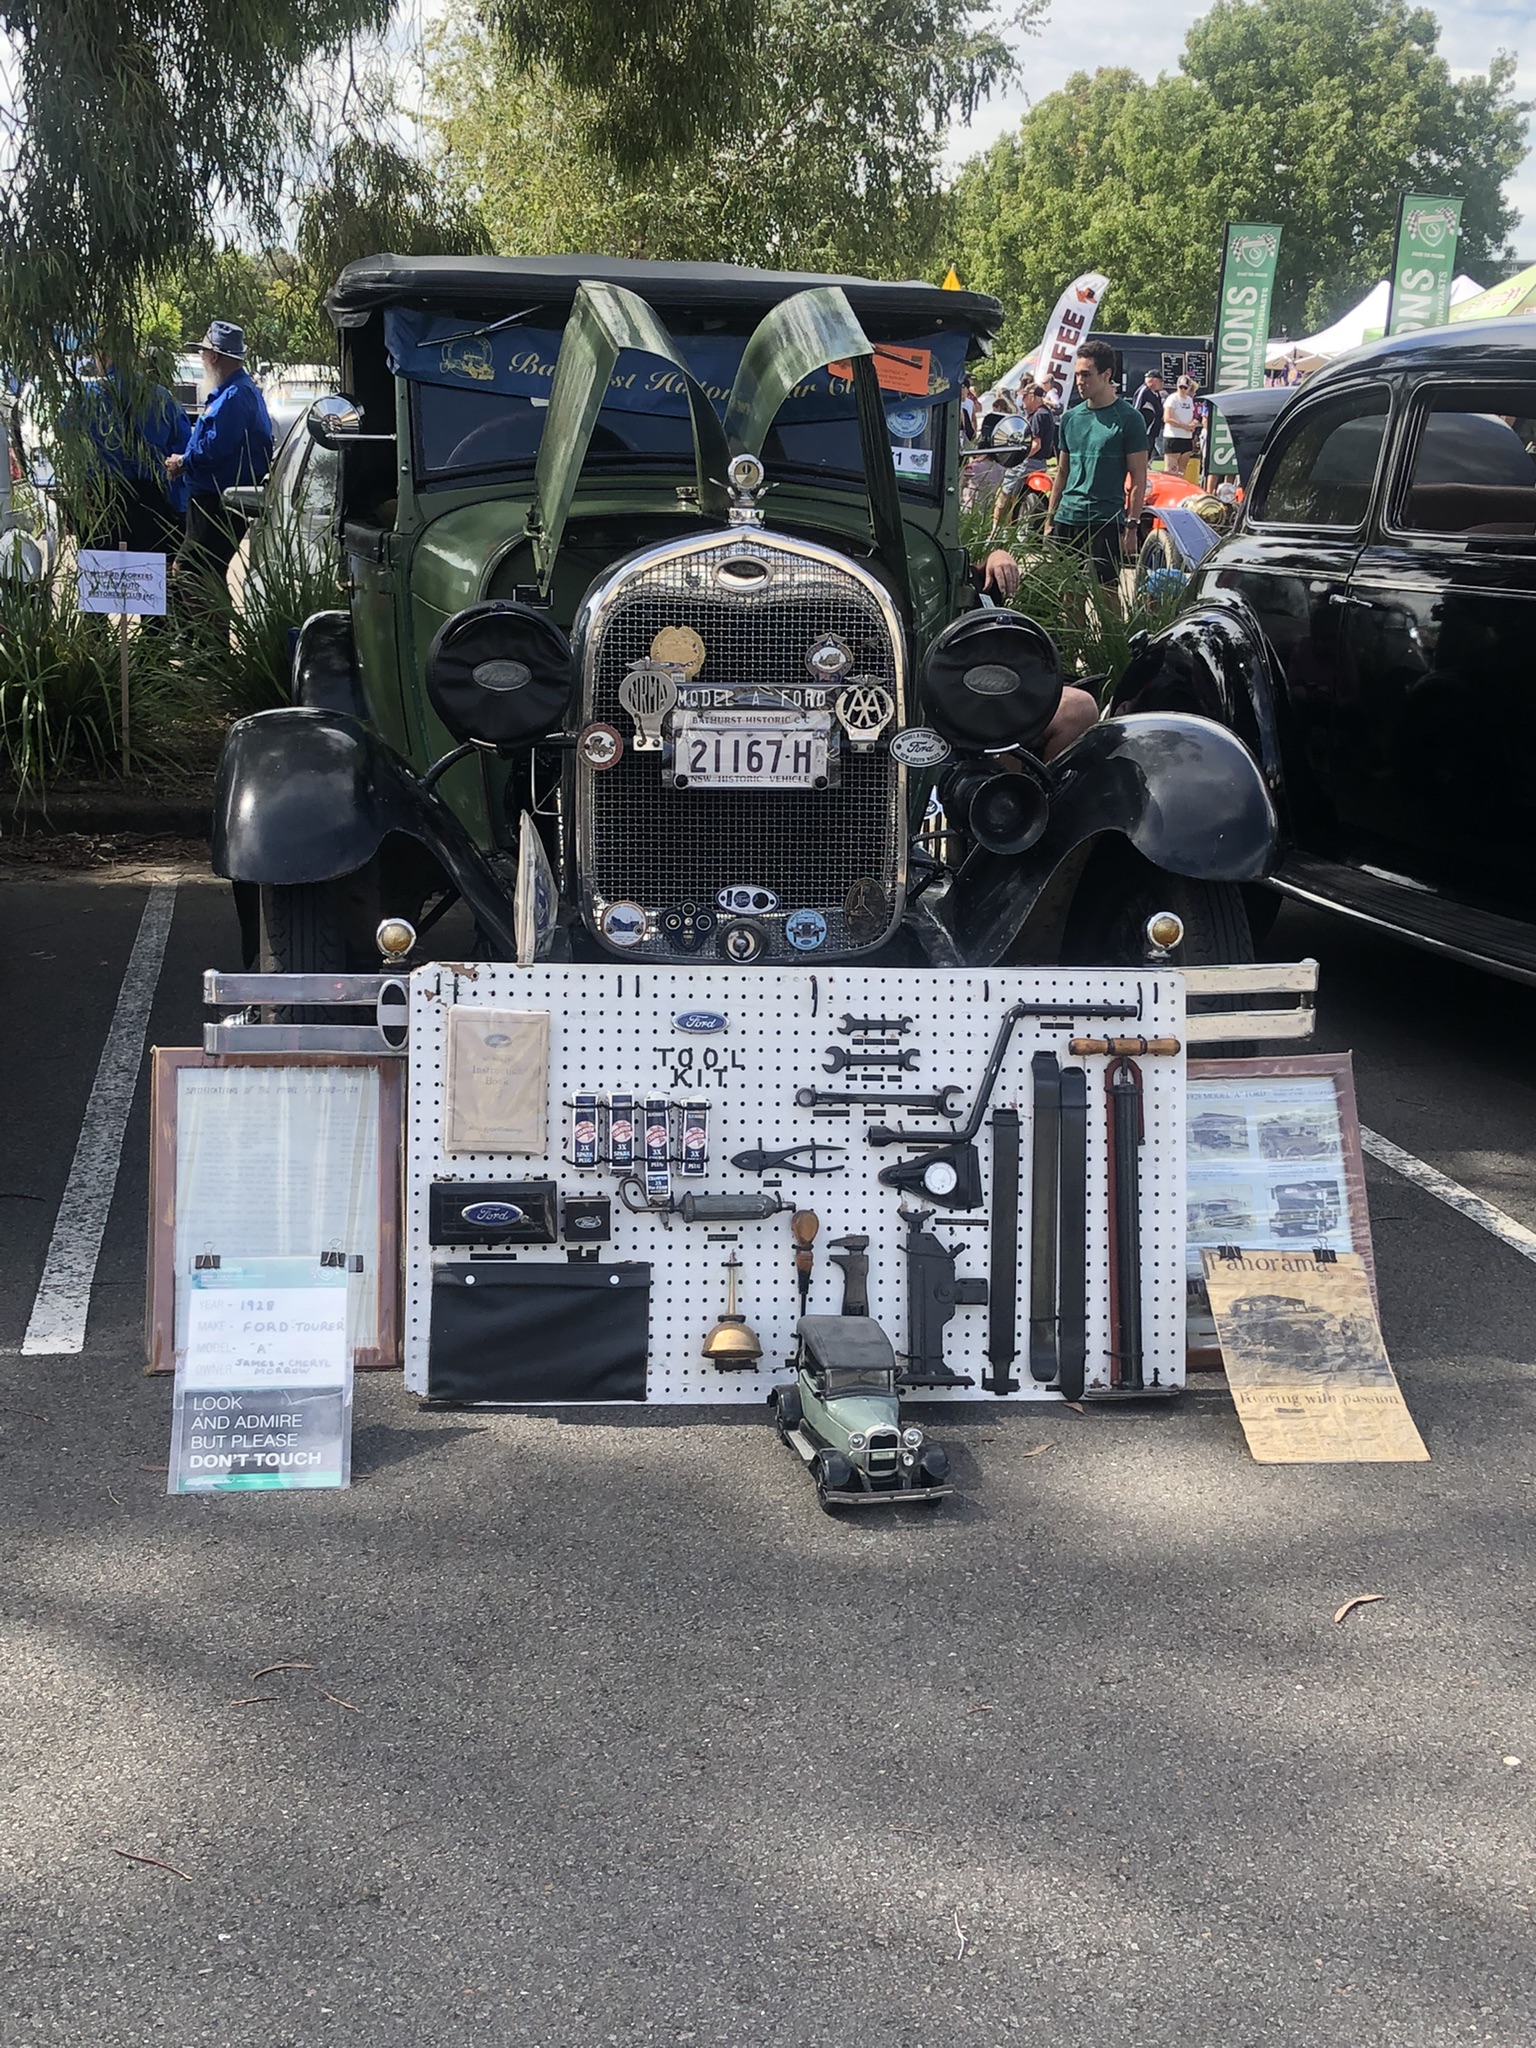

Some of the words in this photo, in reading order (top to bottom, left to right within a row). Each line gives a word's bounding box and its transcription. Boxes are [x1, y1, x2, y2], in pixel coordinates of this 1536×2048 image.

[508, 351, 636, 390] Bast
[677, 690, 734, 707] MODEL
[751, 690, 760, 706] A
[782, 690, 826, 707] FORD
[746, 716, 791, 724] HISTORIC
[906, 741, 935, 753] Ford
[690, 775, 711, 783] NSW
[718, 775, 762, 783] HISTORIC
[769, 775, 810, 783] VEHICLE
[685, 1014, 717, 1028] Ford
[656, 1048, 745, 1068] TOOL
[673, 1068, 728, 1087] KIT
[476, 1207, 509, 1221] Ford
[1207, 1252, 1330, 1273] Panorama
[240, 1301, 275, 1312] 1928
[235, 1358, 275, 1367] JAMES
[289, 1358, 332, 1368] CHERYL
[254, 1367, 311, 1375] MORROW
[193, 1396, 244, 1411] LOOK
[190, 1415, 231, 1430] AND
[234, 1414, 304, 1430] ADMIRE
[190, 1435, 227, 1450] BUT
[231, 1433, 299, 1448] PLEASE
[189, 1454, 250, 1469] DON'T
[253, 1452, 323, 1467] TOUCH
